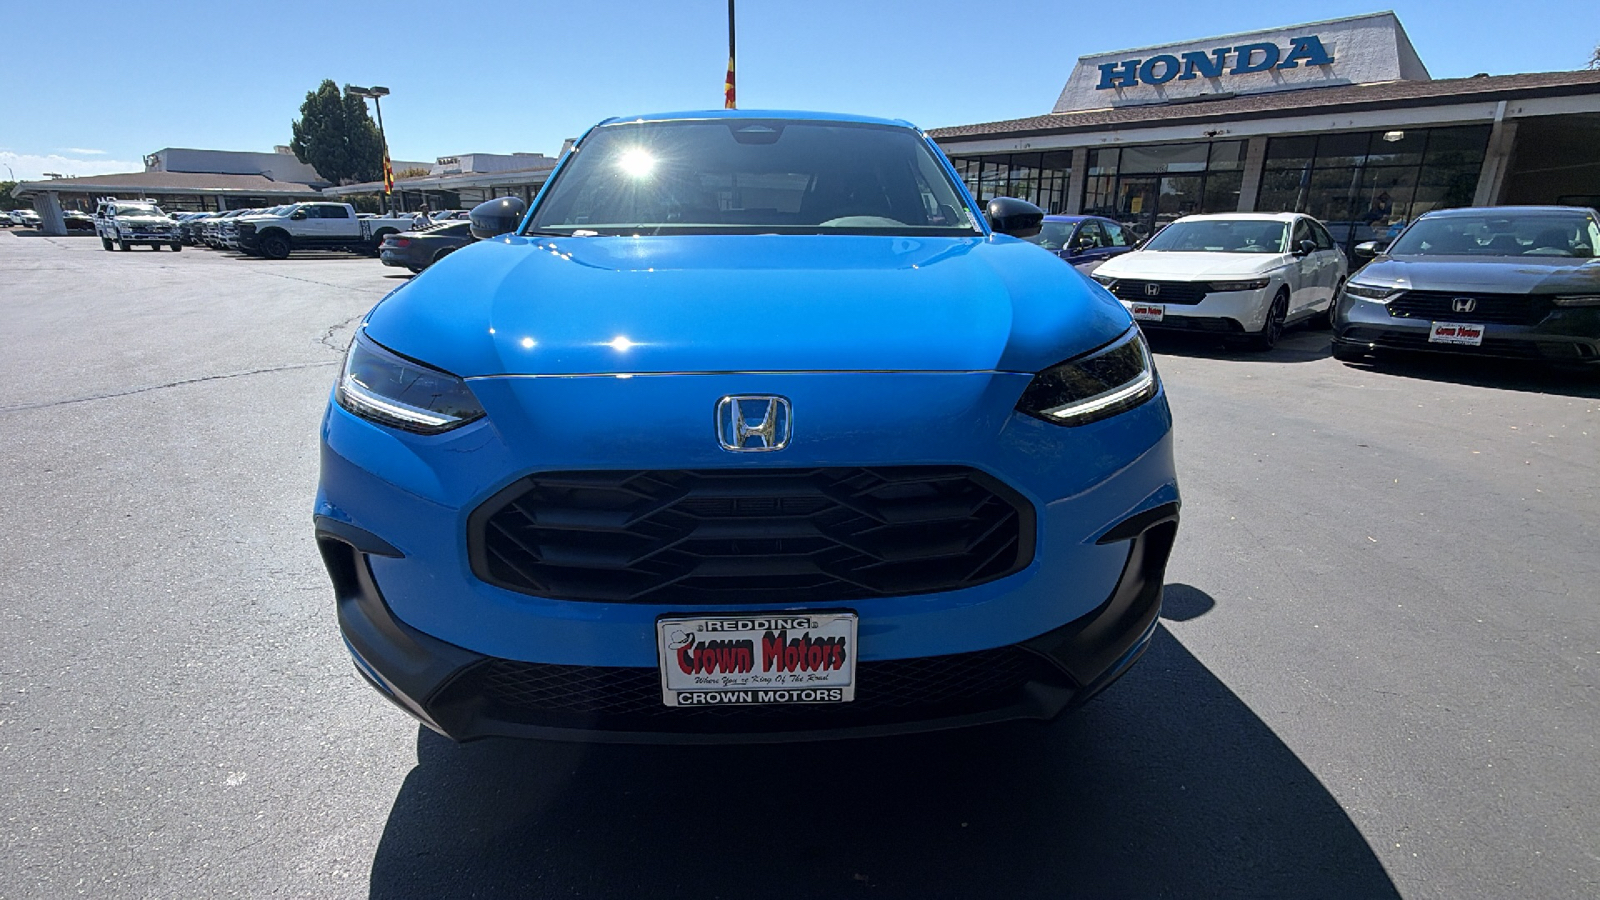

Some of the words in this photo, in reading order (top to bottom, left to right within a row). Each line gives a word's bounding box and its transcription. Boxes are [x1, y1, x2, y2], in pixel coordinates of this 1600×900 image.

[1095, 35, 1335, 90] HONDA
[707, 619, 809, 631] REDDING
[677, 637, 754, 676] Crown
[762, 631, 846, 674] Motors
[694, 676, 719, 684] Where
[751, 674, 772, 685] King
[775, 674, 786, 685] Of
[789, 674, 804, 683] The
[807, 673, 829, 683] Road
[679, 691, 753, 704] CROWN
[758, 689, 841, 703] MOTORS
